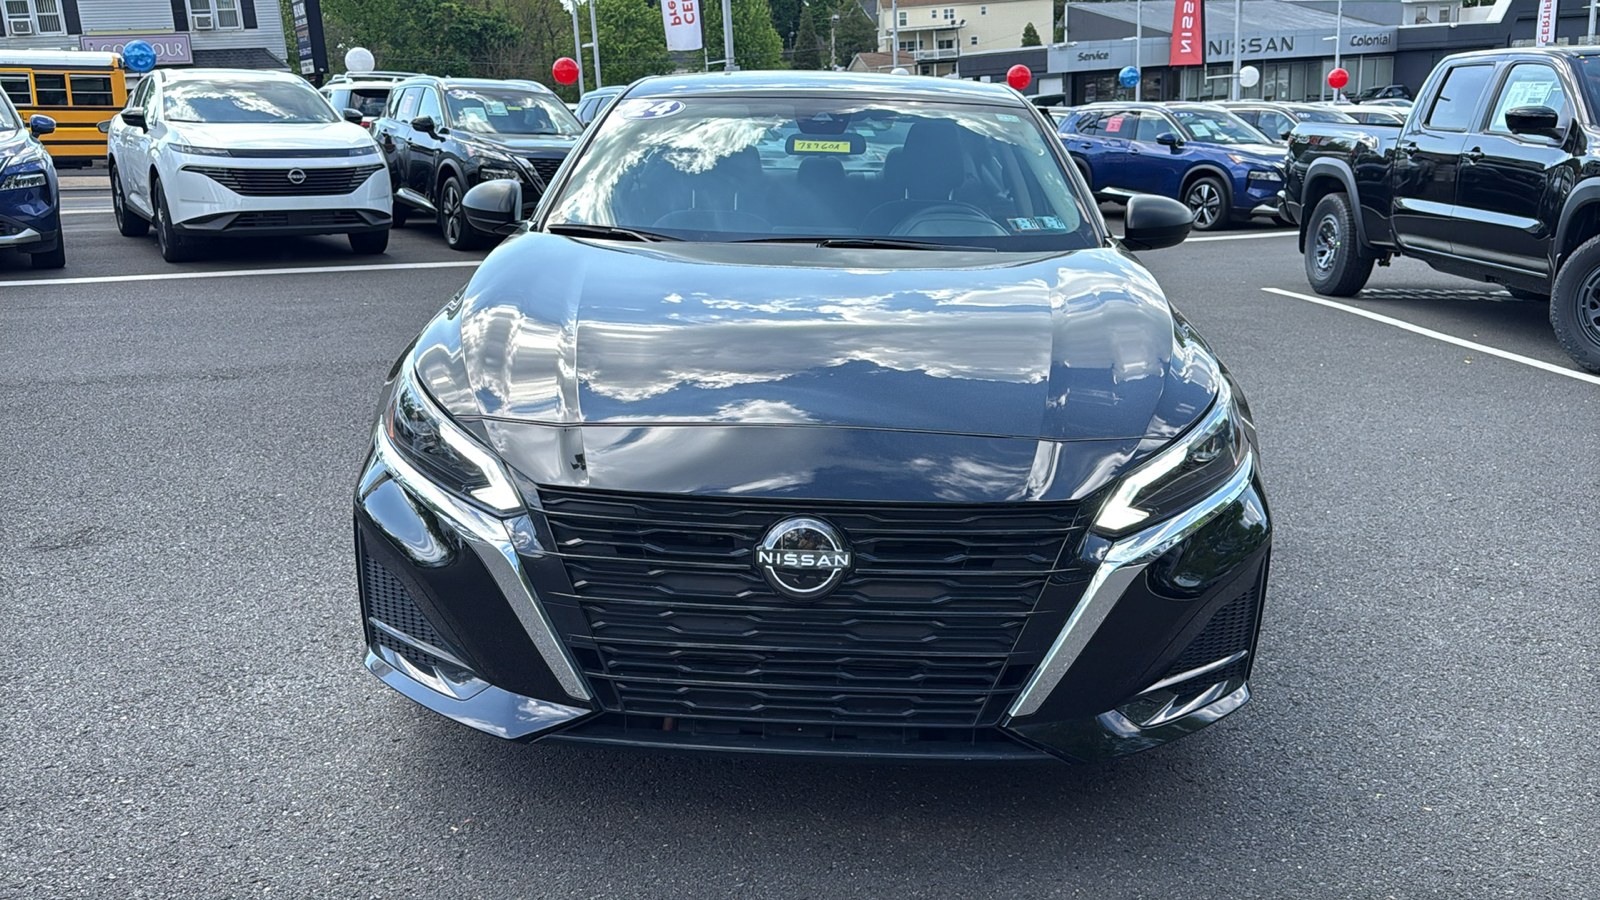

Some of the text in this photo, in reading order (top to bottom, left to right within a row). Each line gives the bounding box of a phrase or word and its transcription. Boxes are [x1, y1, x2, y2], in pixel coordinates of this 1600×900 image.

[1350, 33, 1391, 47] Colonial
[1077, 50, 1109, 61] Service
[758, 551, 849, 566] NISSAN
